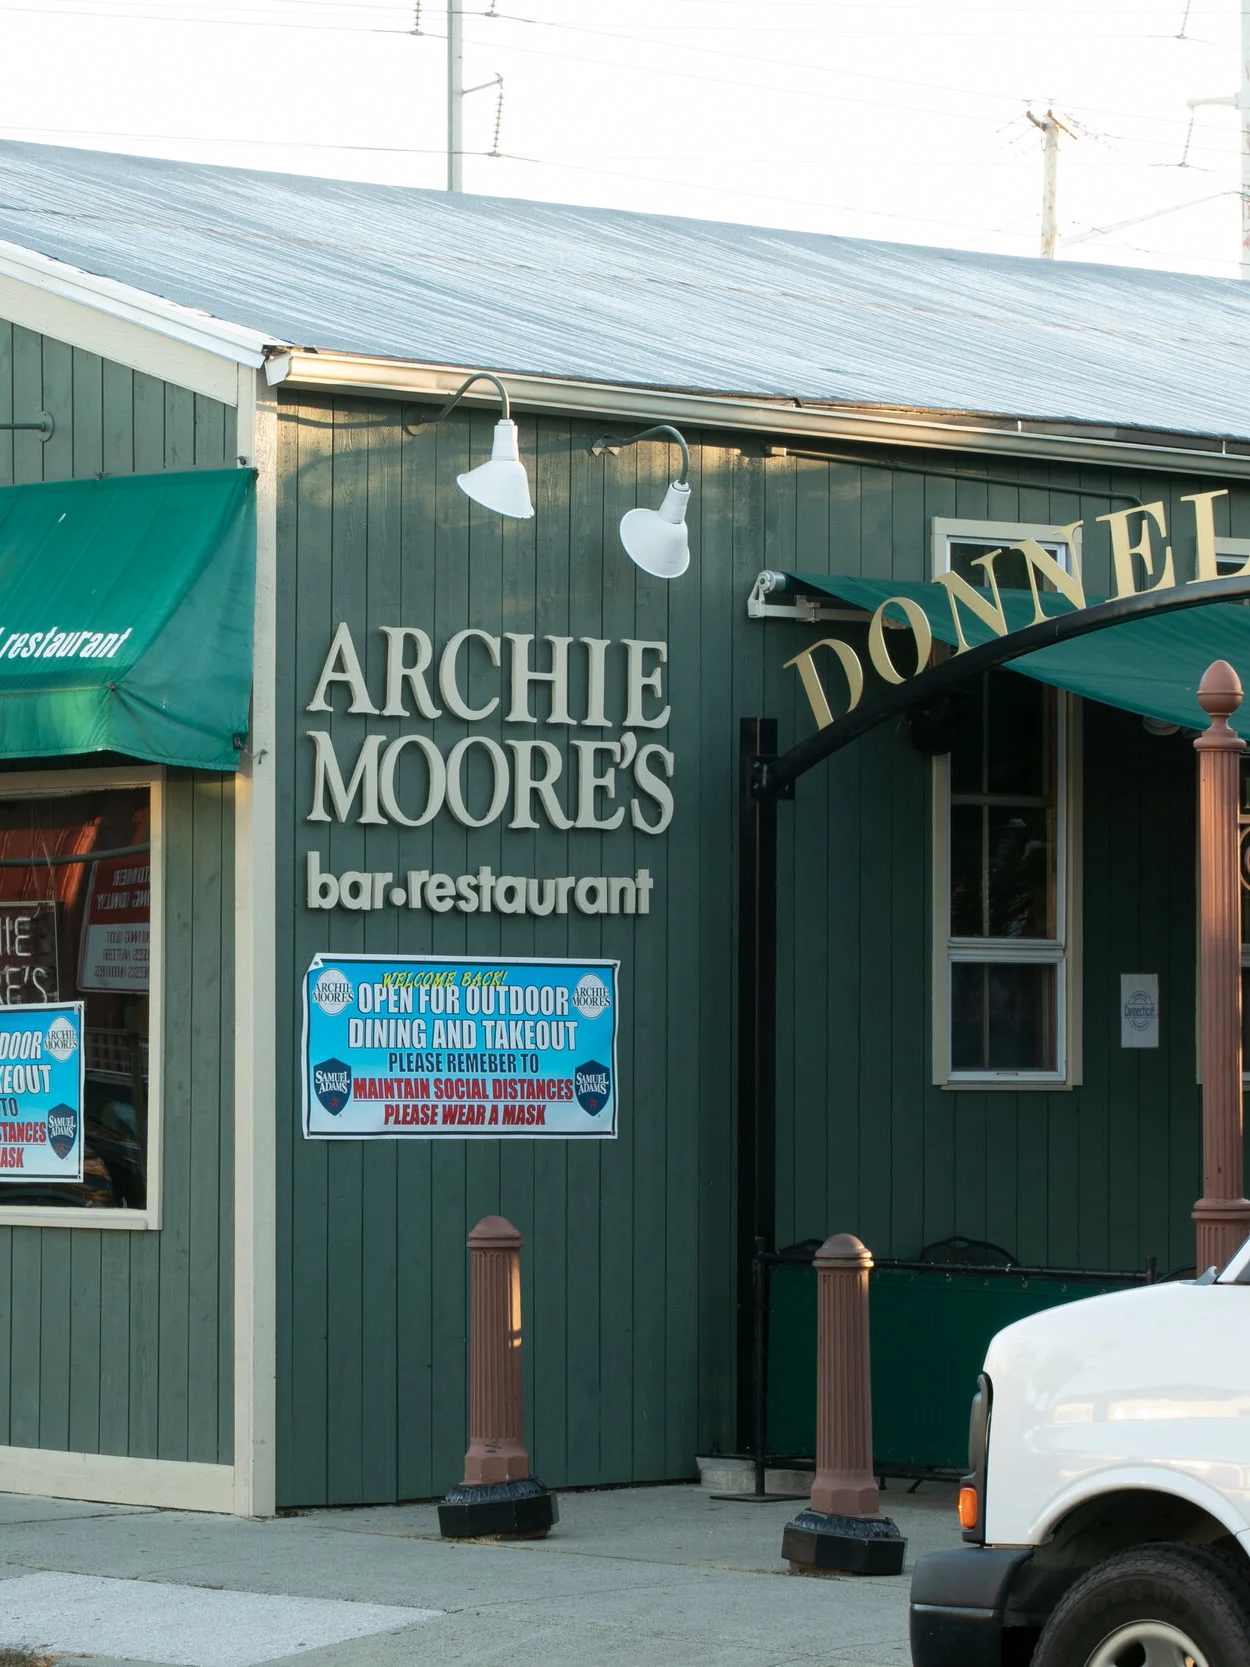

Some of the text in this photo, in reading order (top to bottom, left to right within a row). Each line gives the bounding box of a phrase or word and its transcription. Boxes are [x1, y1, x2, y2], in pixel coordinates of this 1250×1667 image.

[306, 622, 671, 728] ARCHIE
[306, 731, 674, 834] MOORE'S
[382, 970, 507, 988] WELCOME BACK!
[314, 982, 352, 992] ARCHIE
[574, 987, 609, 997] ARCHIE
[358, 982, 570, 1016] OPEN FOR OUTDOOR
[46, 1030, 75, 1039] ARCHIE
[348, 1018, 578, 1050] DINING AND TAKEOUT
[388, 1053, 539, 1074] PLEASE REMEBER TO
[316, 1071, 349, 1083] SAMUEL
[576, 1072, 609, 1085] SAMUEL
[319, 1082, 348, 1094] ADAMS
[353, 1078, 573, 1100] MAINTAIN SOCIAL DISTANCES
[578, 1083, 607, 1095] ADAMS
[1, 1098, 18, 1116] TO
[384, 1104, 546, 1125] PLEASE WEAR A MASK
[49, 1115, 76, 1128] SAMUEL
[51, 1126, 73, 1137] ADAMS
